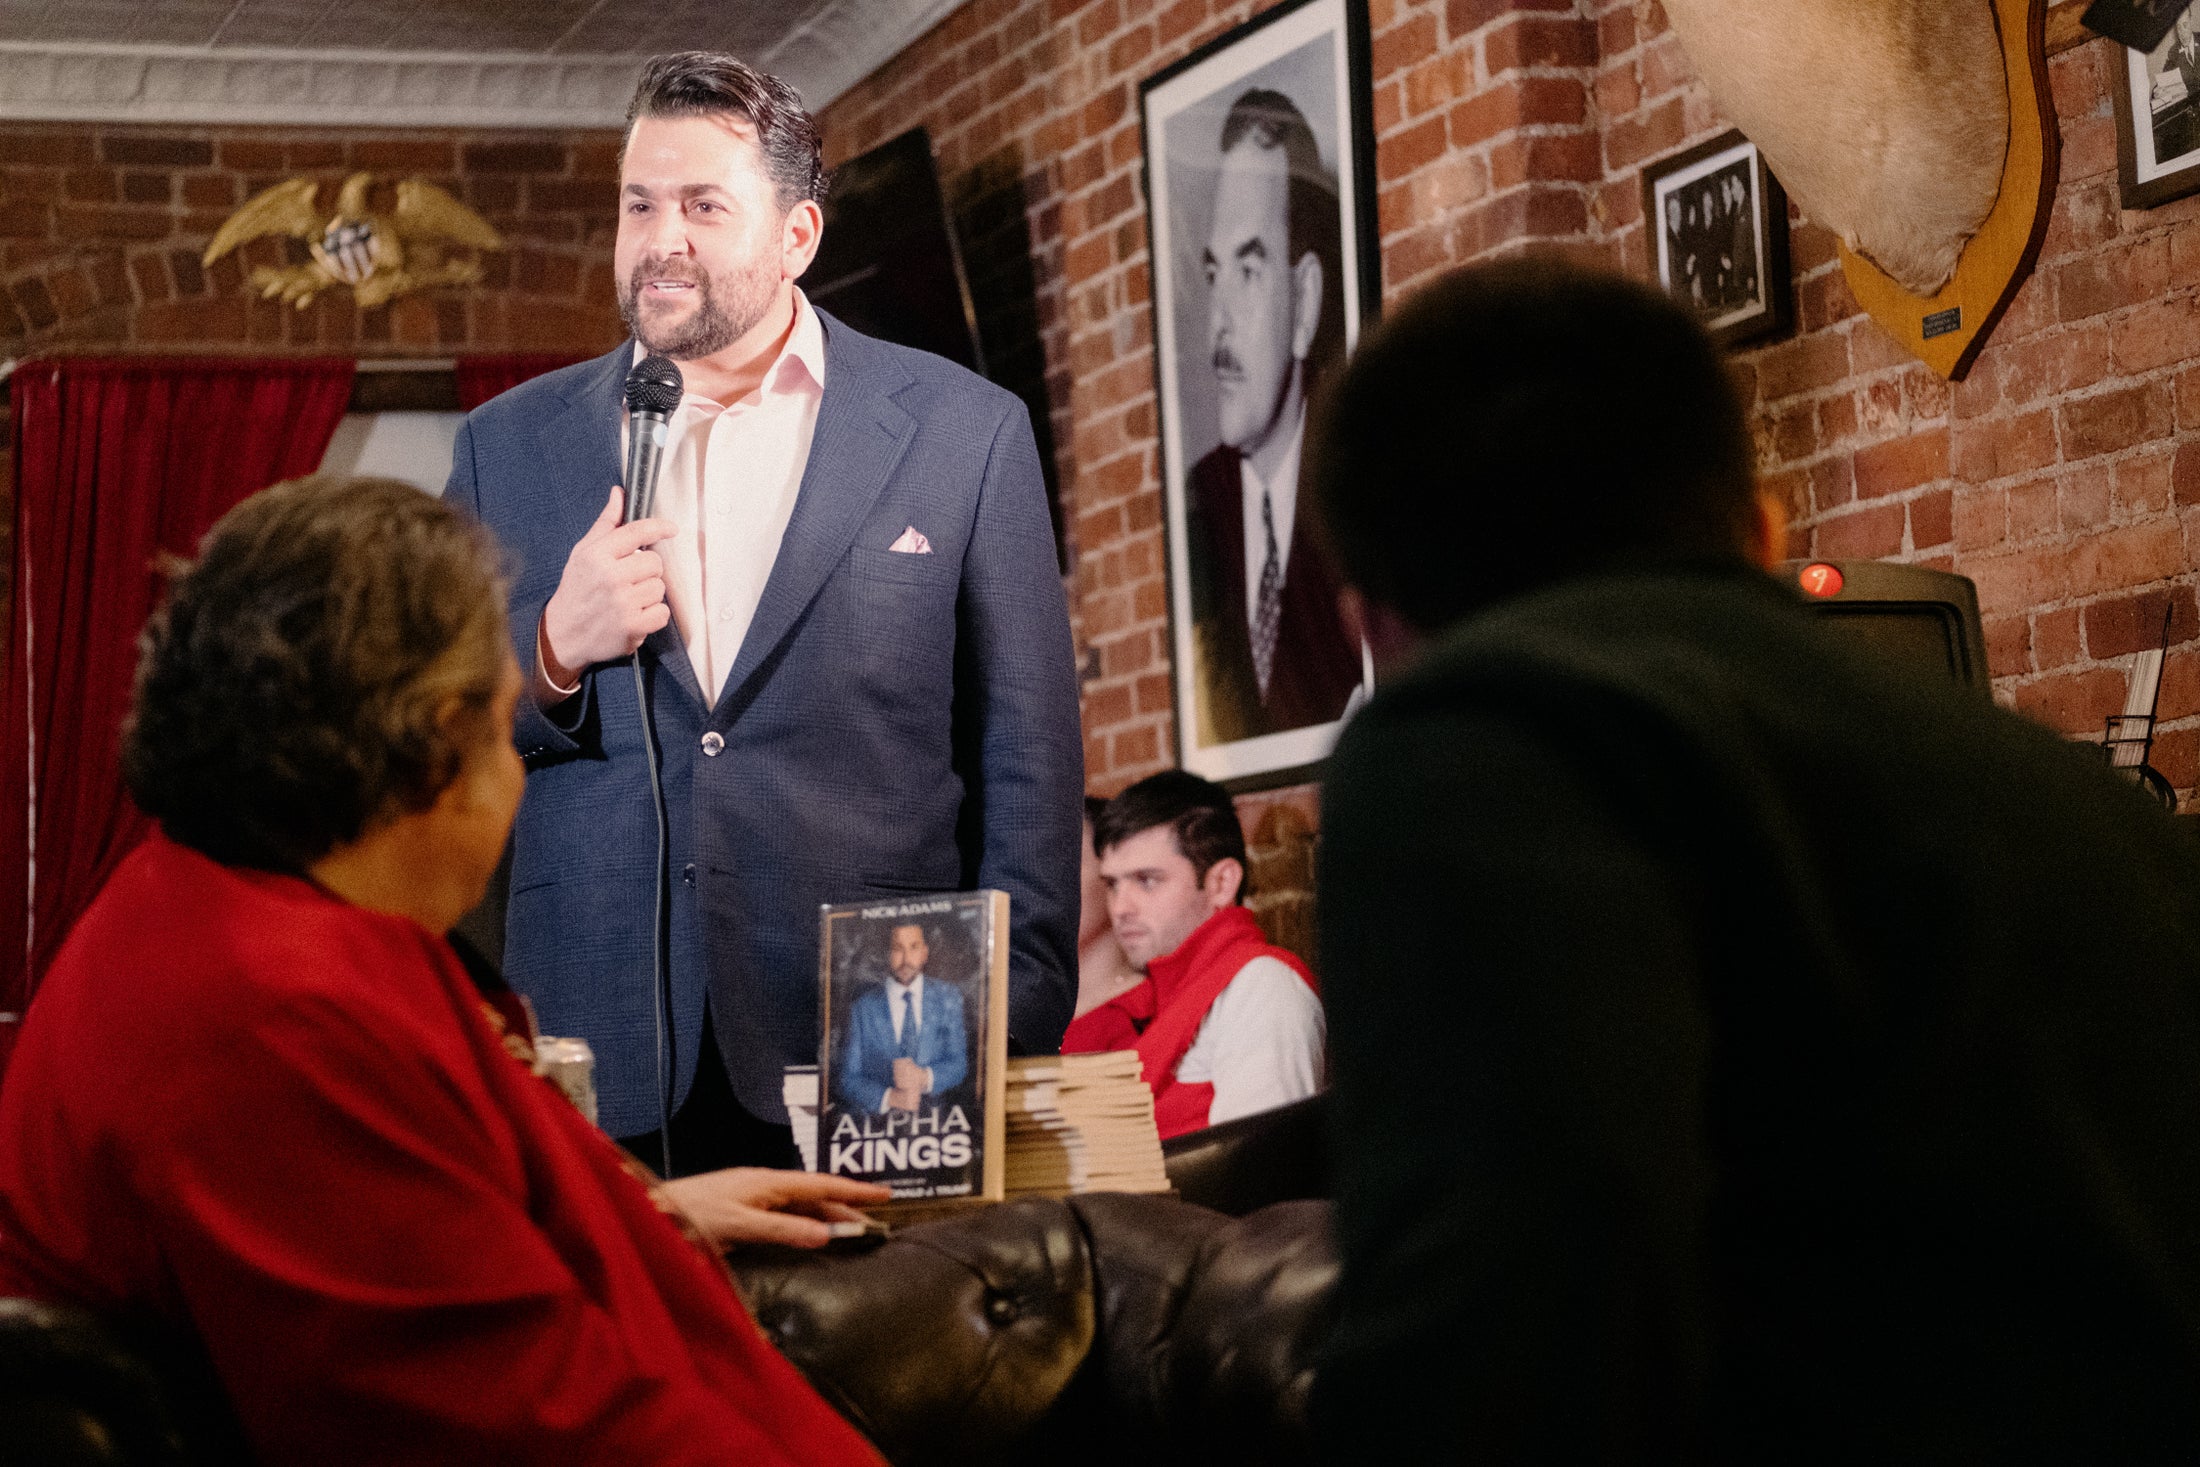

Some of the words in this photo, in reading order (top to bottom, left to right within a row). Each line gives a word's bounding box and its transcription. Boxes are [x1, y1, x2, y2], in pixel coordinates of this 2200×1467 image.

[861, 906, 898, 920] NICK
[899, 901, 953, 916] ADAMS
[830, 1104, 972, 1141] ALPHA
[829, 1133, 972, 1174] KINGS
